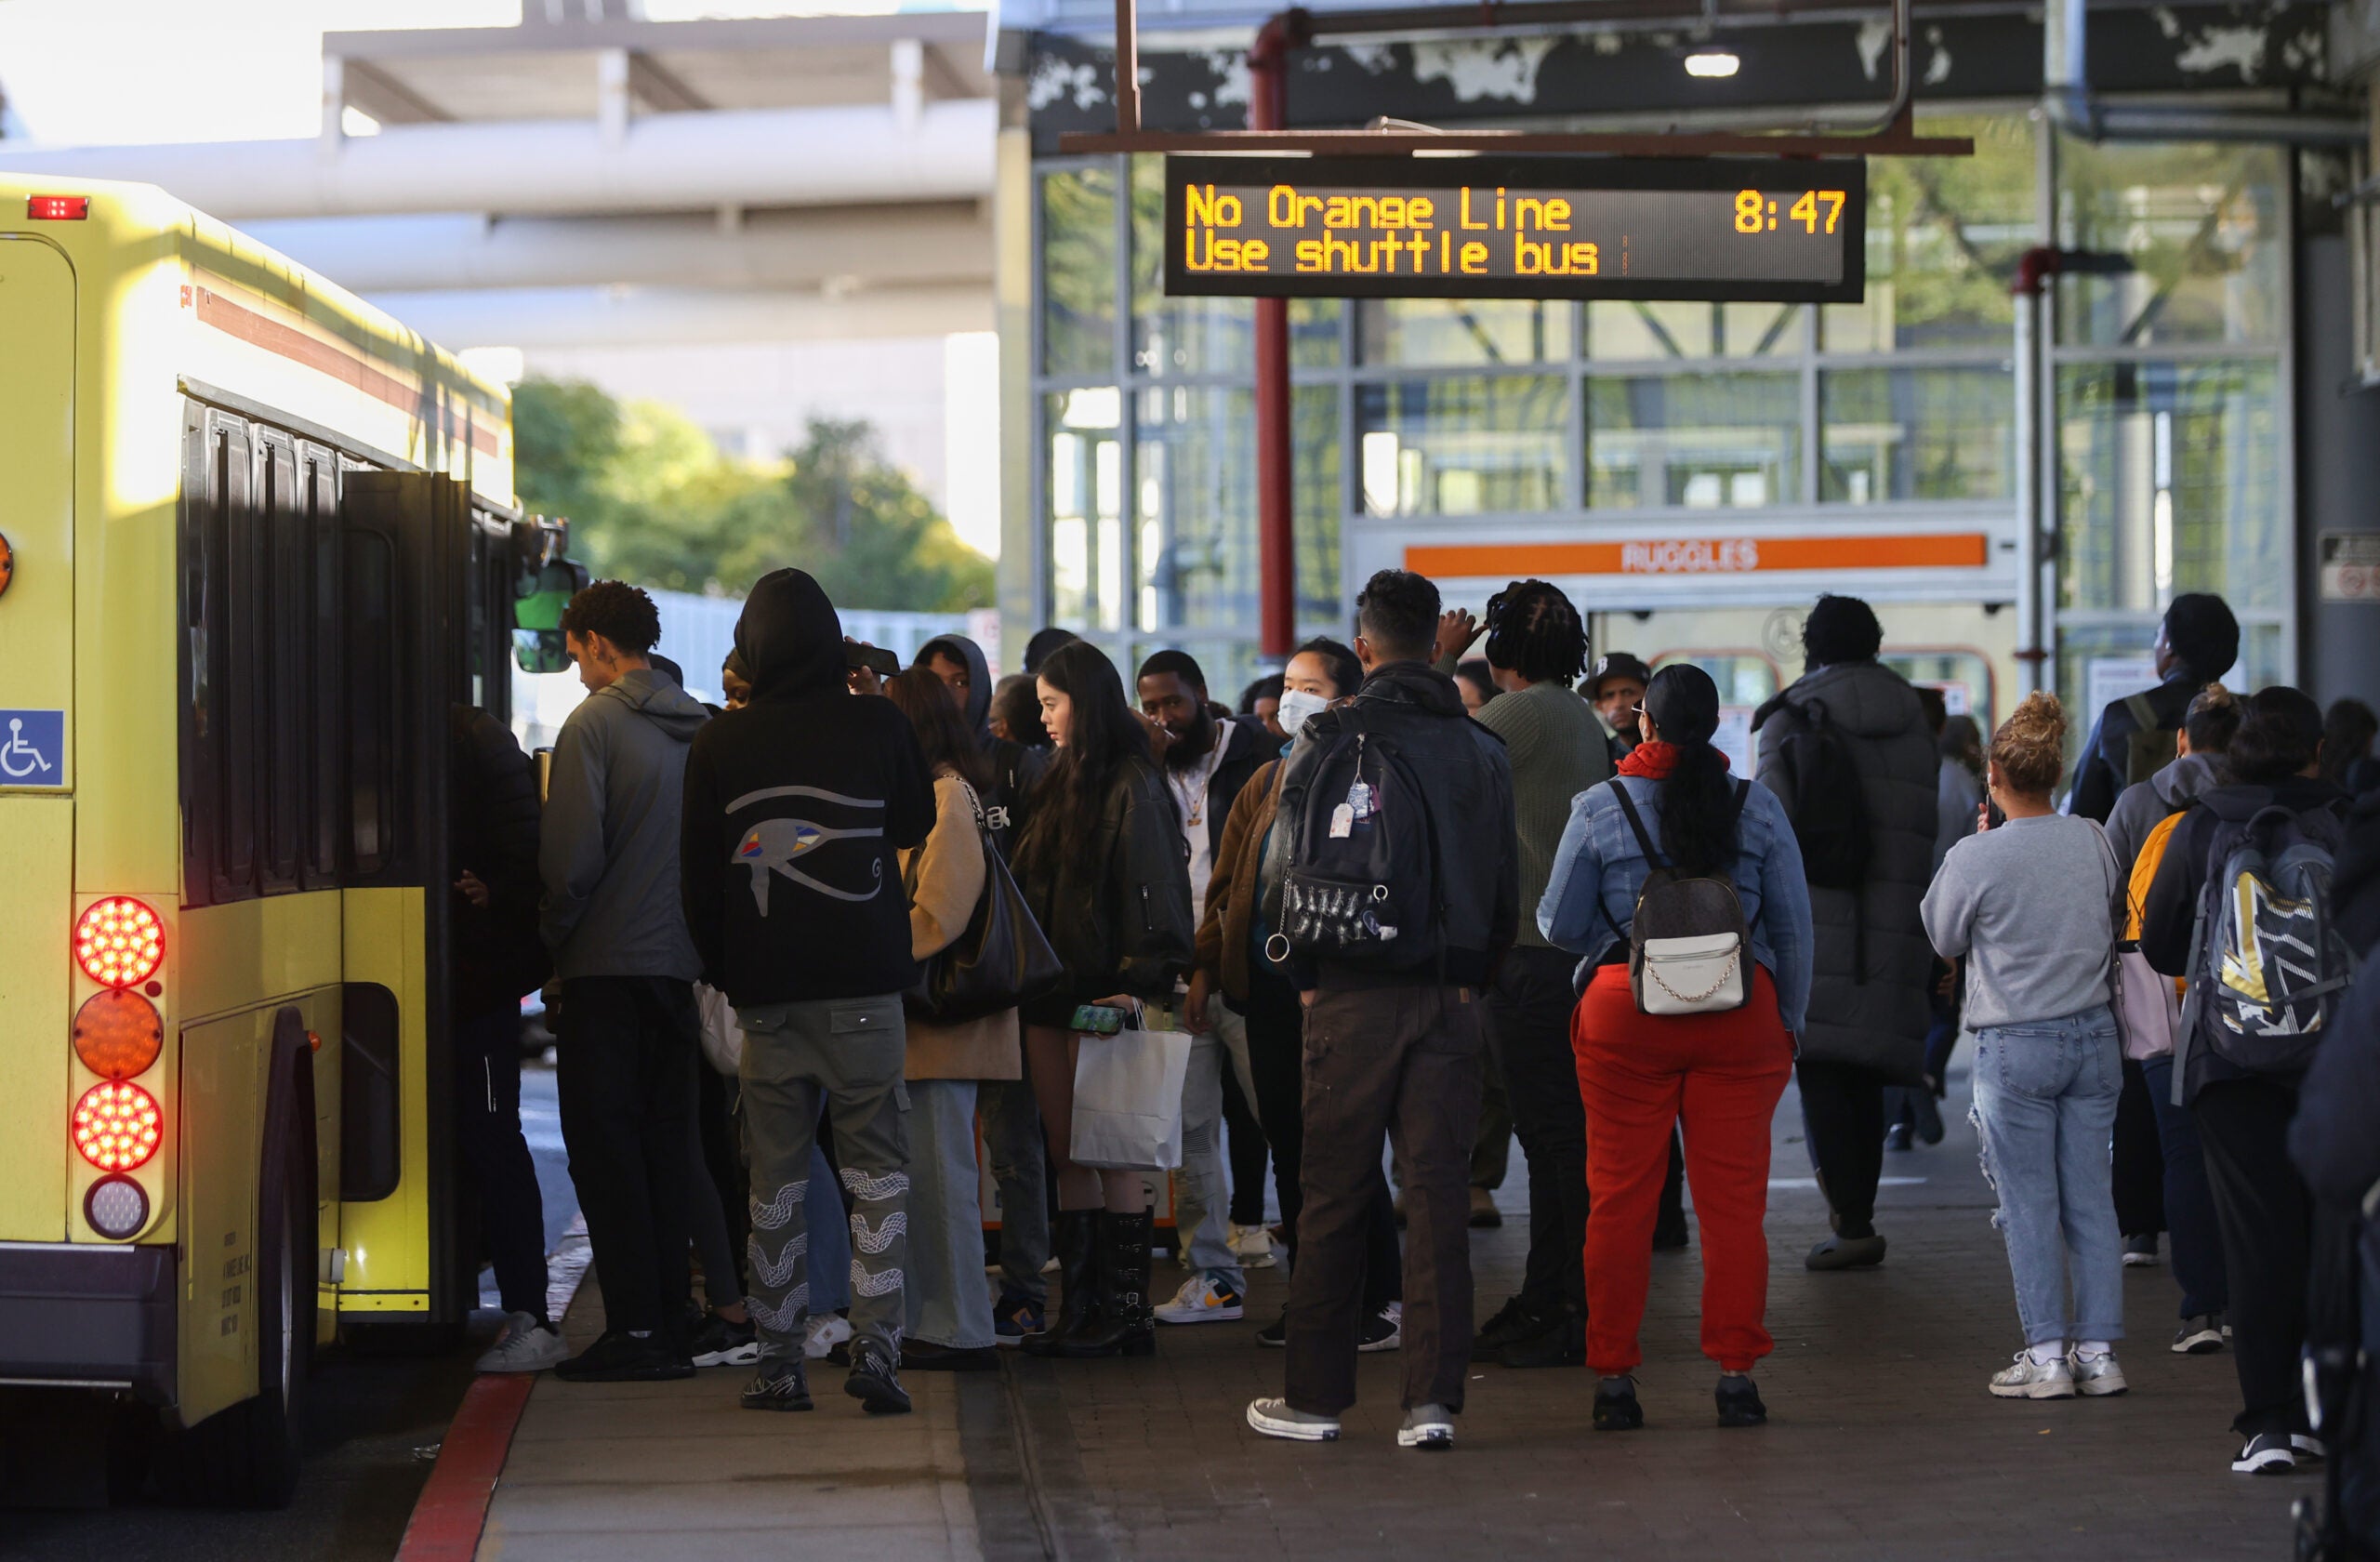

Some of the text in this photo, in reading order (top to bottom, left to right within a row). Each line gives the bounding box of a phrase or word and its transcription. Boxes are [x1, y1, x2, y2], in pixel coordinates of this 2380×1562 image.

[1186, 184, 1571, 231] No Orange Line
[1735, 189, 1845, 234] 8:47
[1185, 228, 1598, 275] Use shuttle bus
[1621, 539, 1757, 574] RUGGLES
